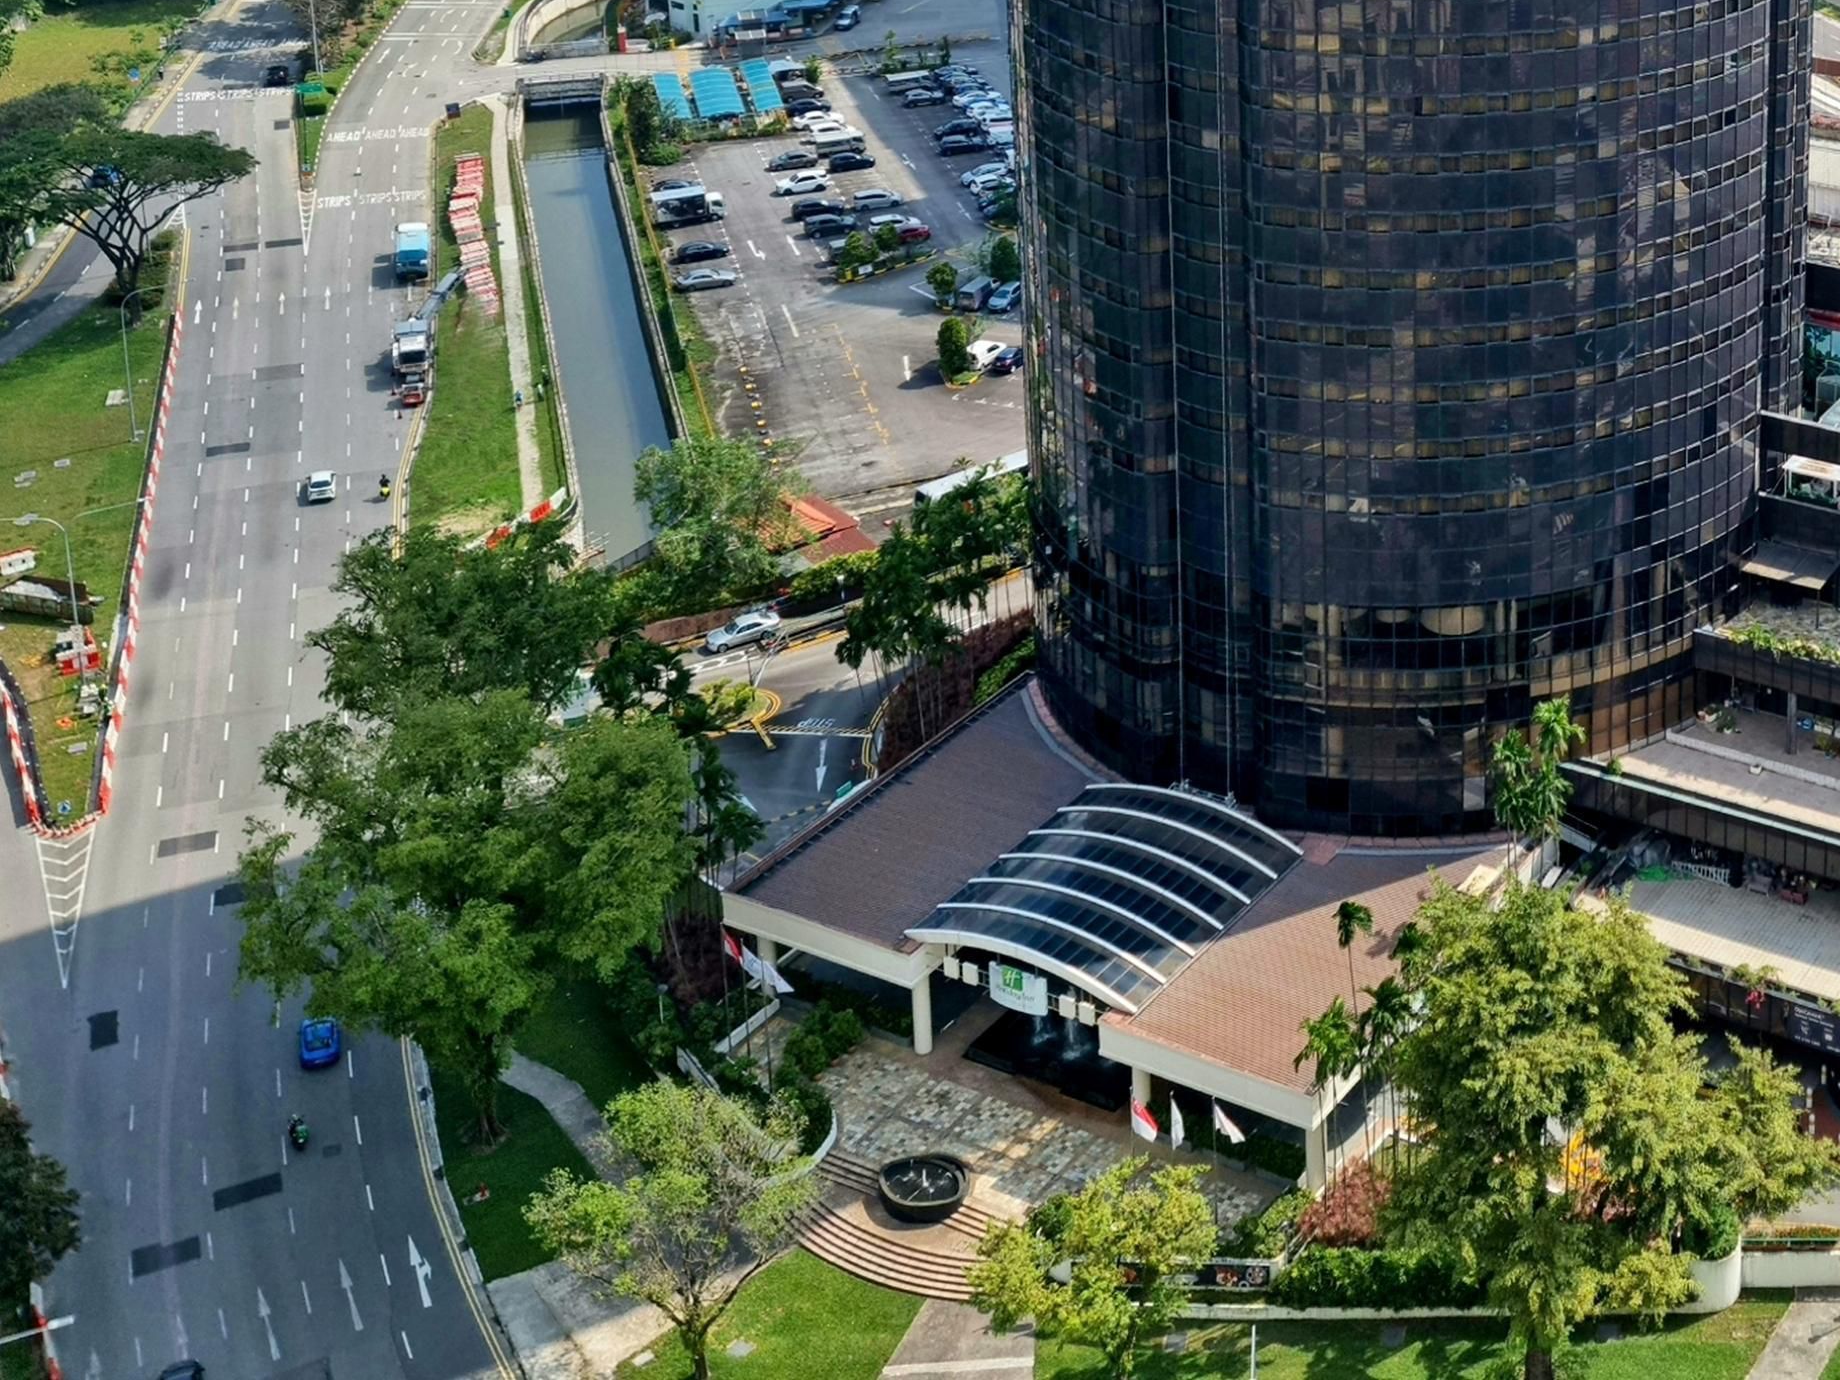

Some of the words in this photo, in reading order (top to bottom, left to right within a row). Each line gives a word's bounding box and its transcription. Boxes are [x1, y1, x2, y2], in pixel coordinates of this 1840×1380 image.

[184, 91, 215, 102] STRIPS
[218, 89, 253, 100] STRIPS
[326, 131, 361, 142] AHEAD
[365, 129, 397, 141] AHEAD
[400, 127, 429, 138] AHEAD
[318, 195, 351, 208] STRIPS
[360, 192, 392, 205] STRIPS
[393, 190, 426, 203] STRIPS
